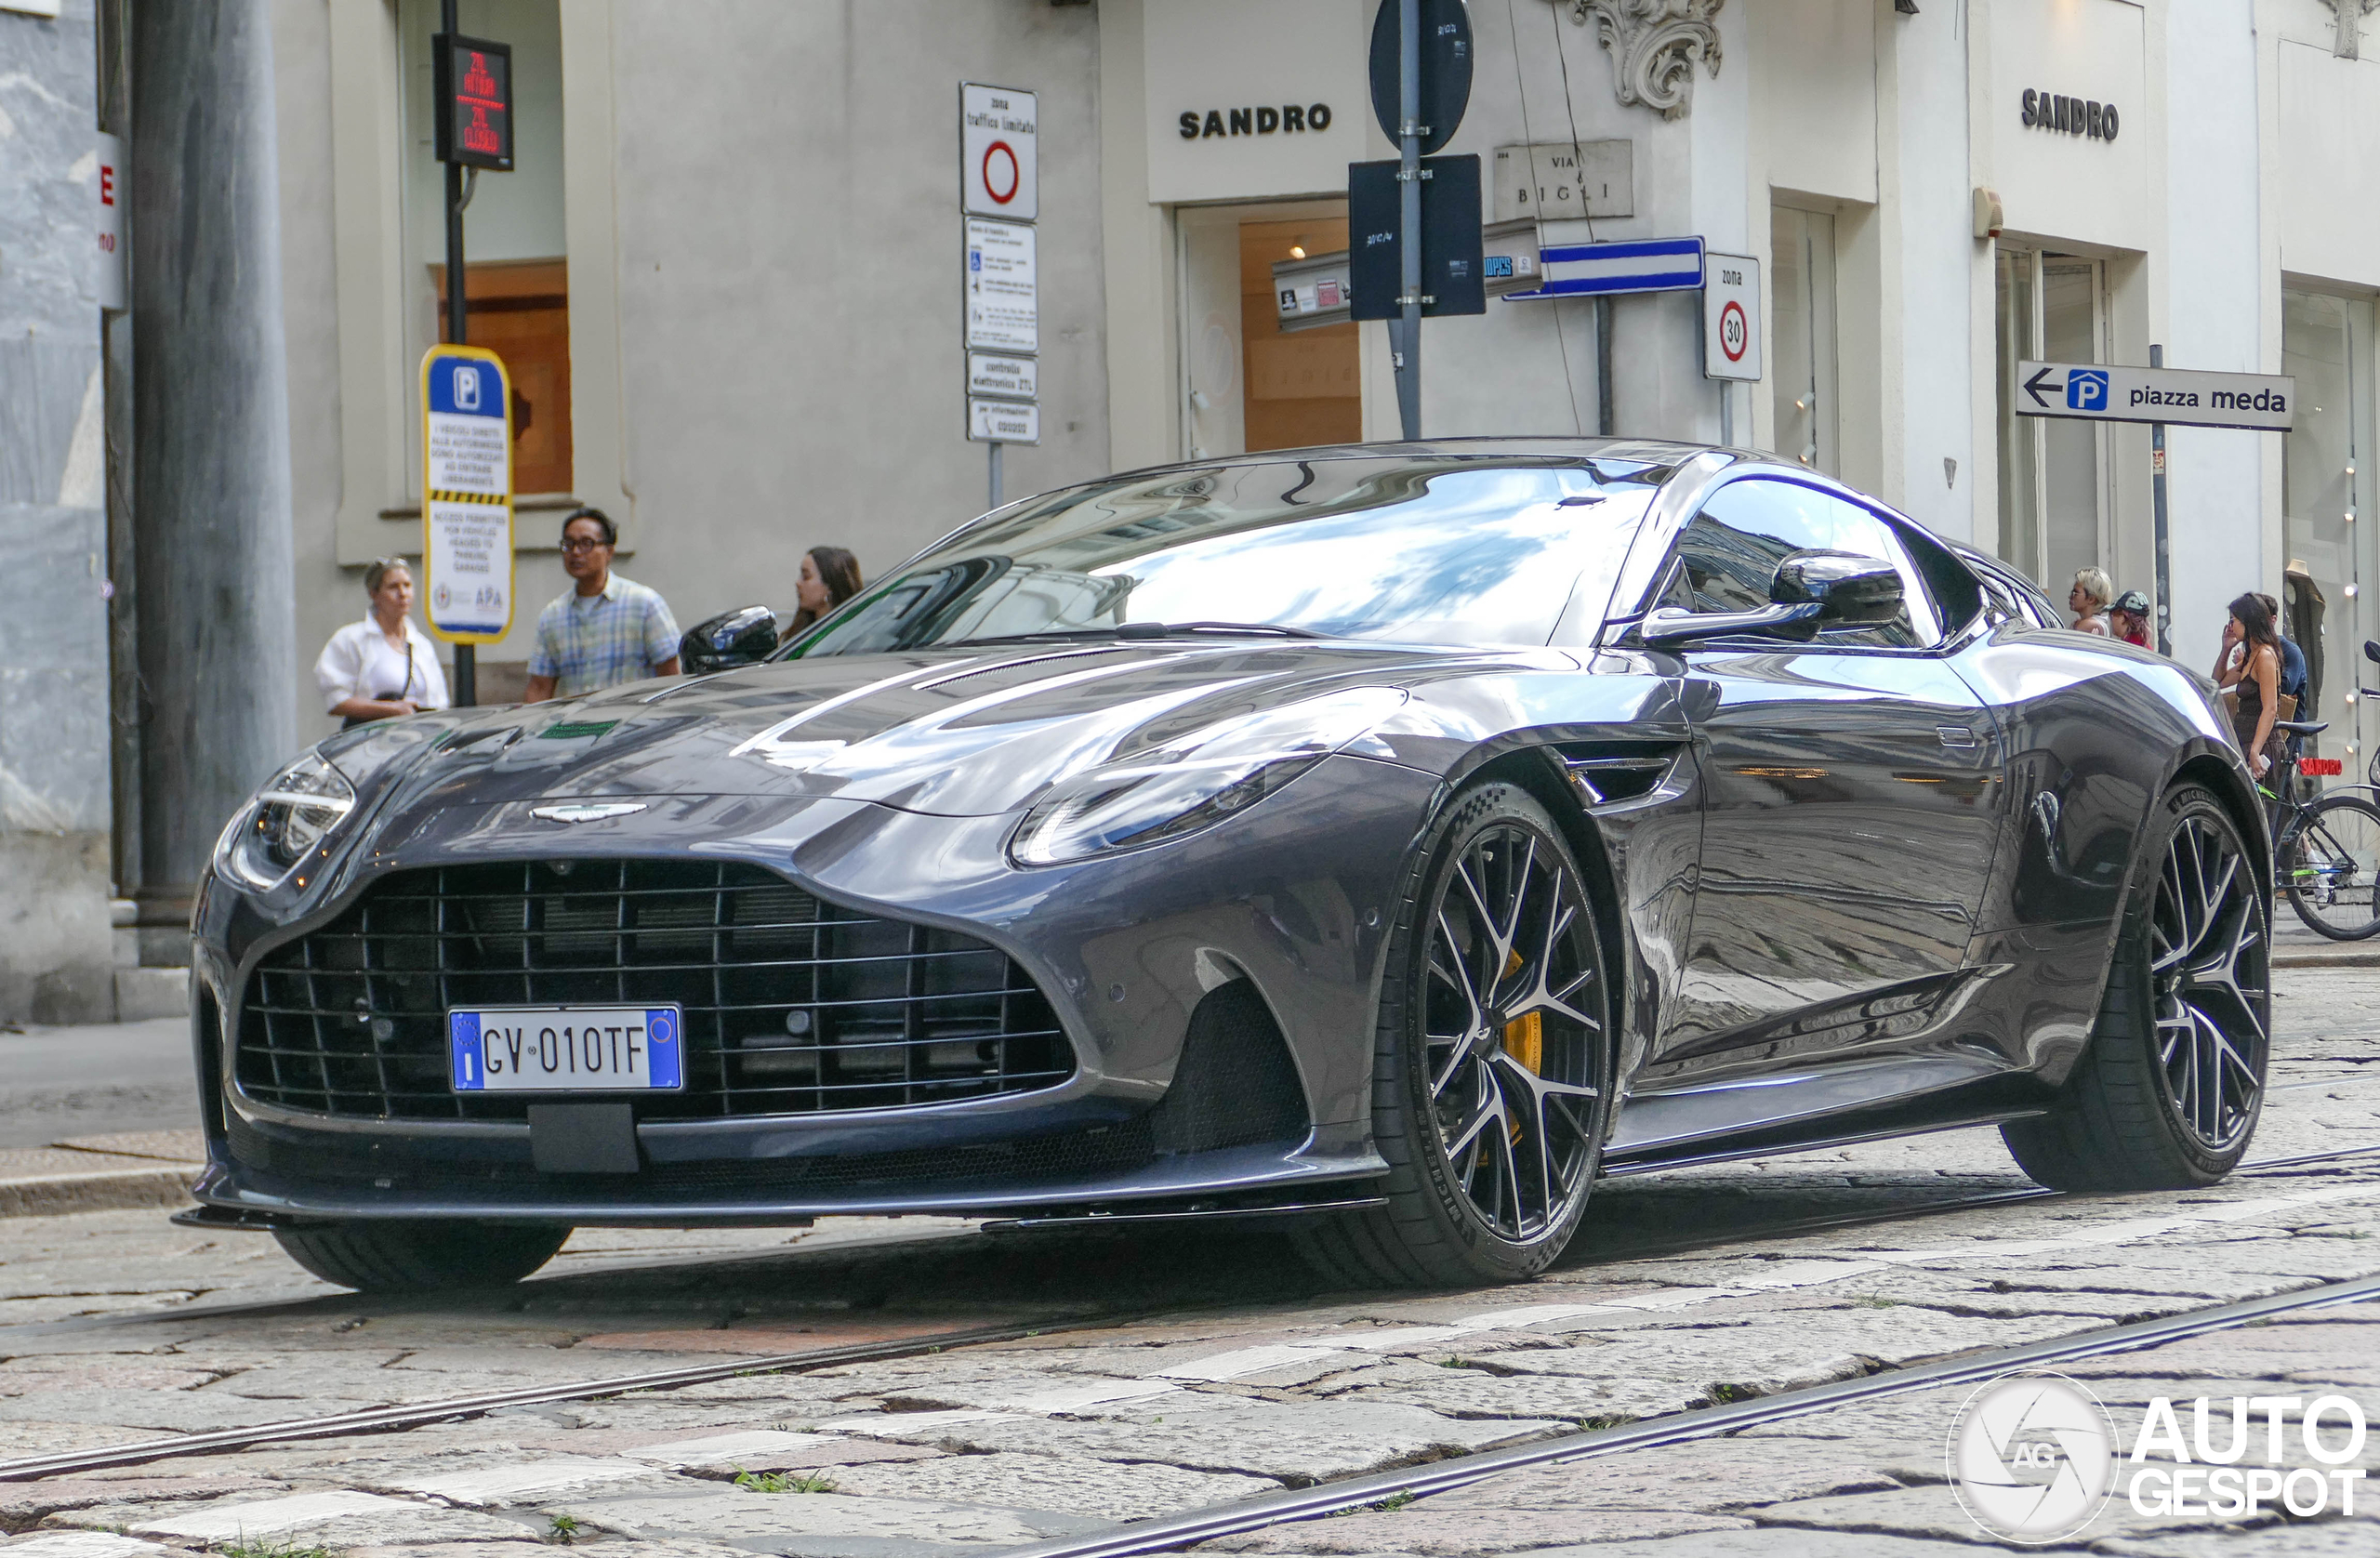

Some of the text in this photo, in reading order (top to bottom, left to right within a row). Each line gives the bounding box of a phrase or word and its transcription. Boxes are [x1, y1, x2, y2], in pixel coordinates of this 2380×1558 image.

[968, 112, 1035, 134] traffico limitato
[1180, 103, 1331, 139] SANDRO
[2022, 87, 2120, 140] SANDRO
[1552, 157, 1574, 168] VIA
[1518, 184, 1608, 204] BIGLI
[1484, 257, 1513, 277] OPES
[1722, 270, 1742, 285] zona
[1727, 320, 1740, 343] 30
[459, 372, 475, 403] P
[2077, 381, 2287, 413] P piazza meda
[475, 587, 503, 609] APA
[2299, 758, 2342, 776] SANDRO
[1416, 1109, 1462, 1222] MICHELIN
